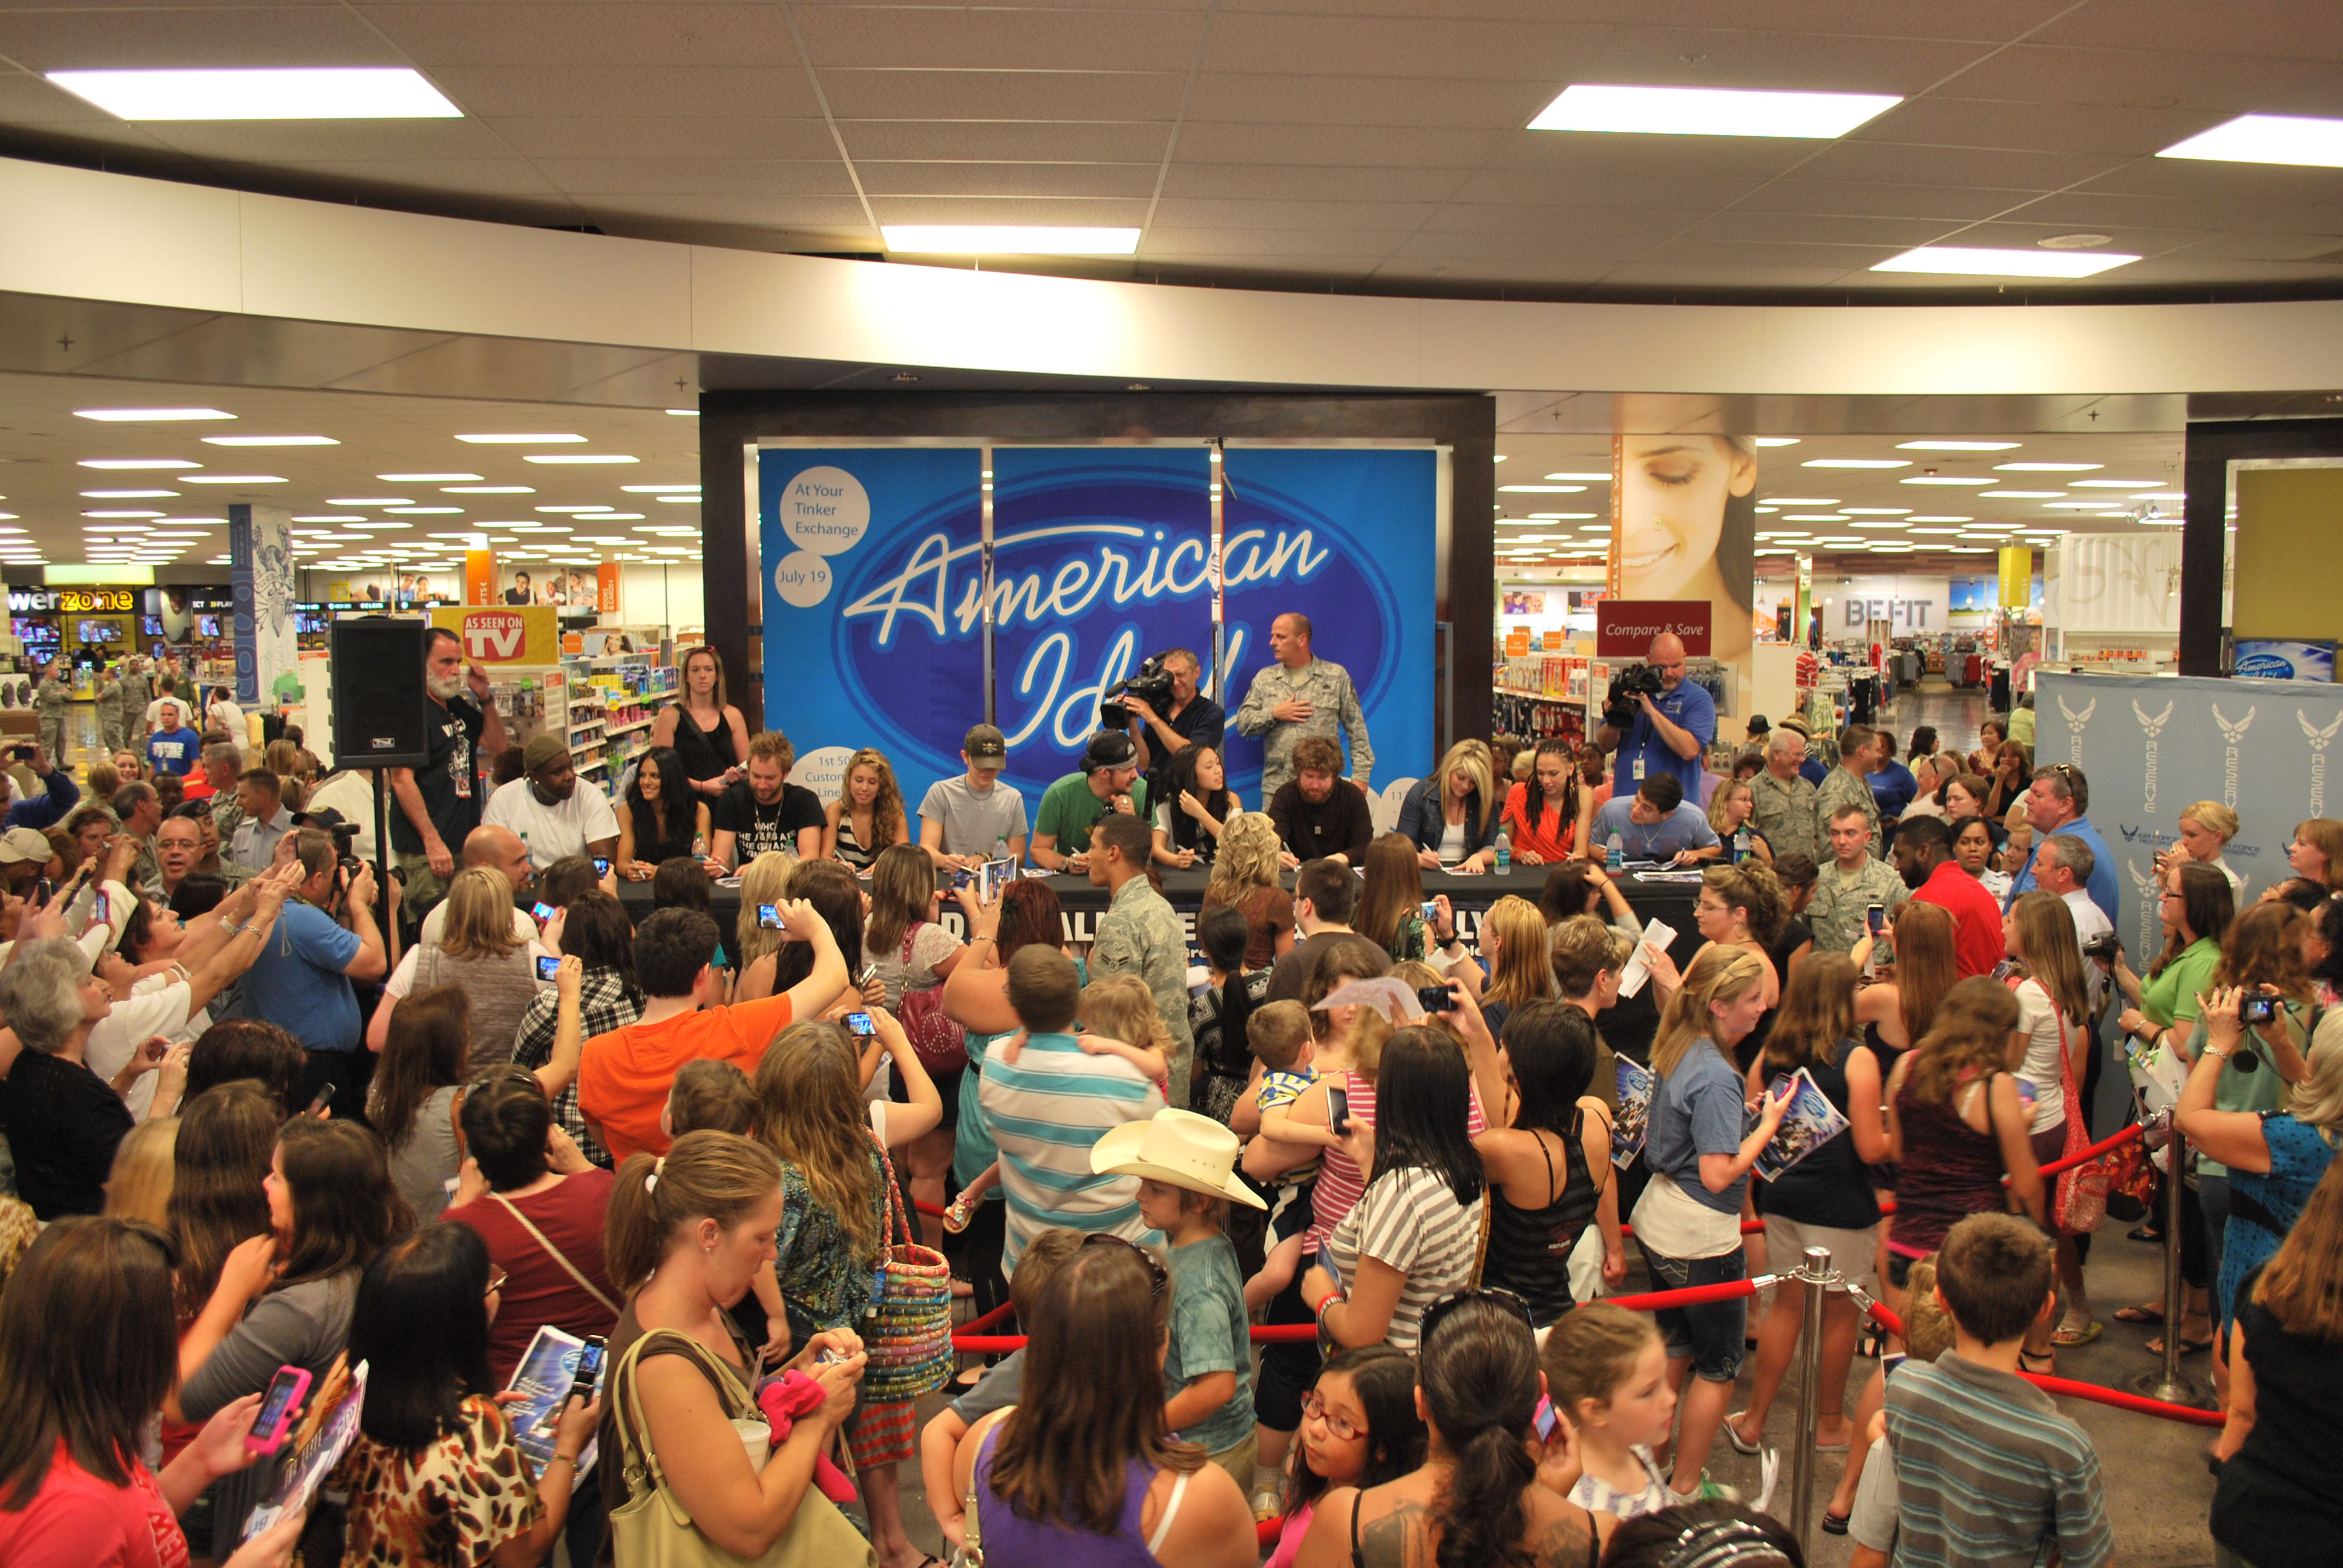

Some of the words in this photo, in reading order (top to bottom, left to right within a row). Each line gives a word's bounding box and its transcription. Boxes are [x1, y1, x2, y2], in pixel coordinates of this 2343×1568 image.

[795, 484, 808, 497] At
[811, 485, 844, 497] Your
[795, 502, 836, 515] Tinker
[795, 521, 859, 537] Exchange
[779, 570, 806, 585] July
[810, 570, 826, 583] 19
[842, 523, 1329, 645] American
[465, 616, 479, 629] AS
[480, 616, 506, 629] SEEN
[507, 616, 523, 629] ON
[1605, 623, 1661, 639] Compare
[1676, 623, 1704, 636] Save
[465, 629, 523, 657] TV
[2235, 659, 2287, 673] American
[1004, 629, 1244, 748] Idl
[819, 756, 834, 766] 1st
[2144, 740, 2157, 813] RESERVE
[2224, 746, 2238, 811] RESERV
[818, 788, 841, 797] Line
[2310, 753, 2325, 819] RESERV
